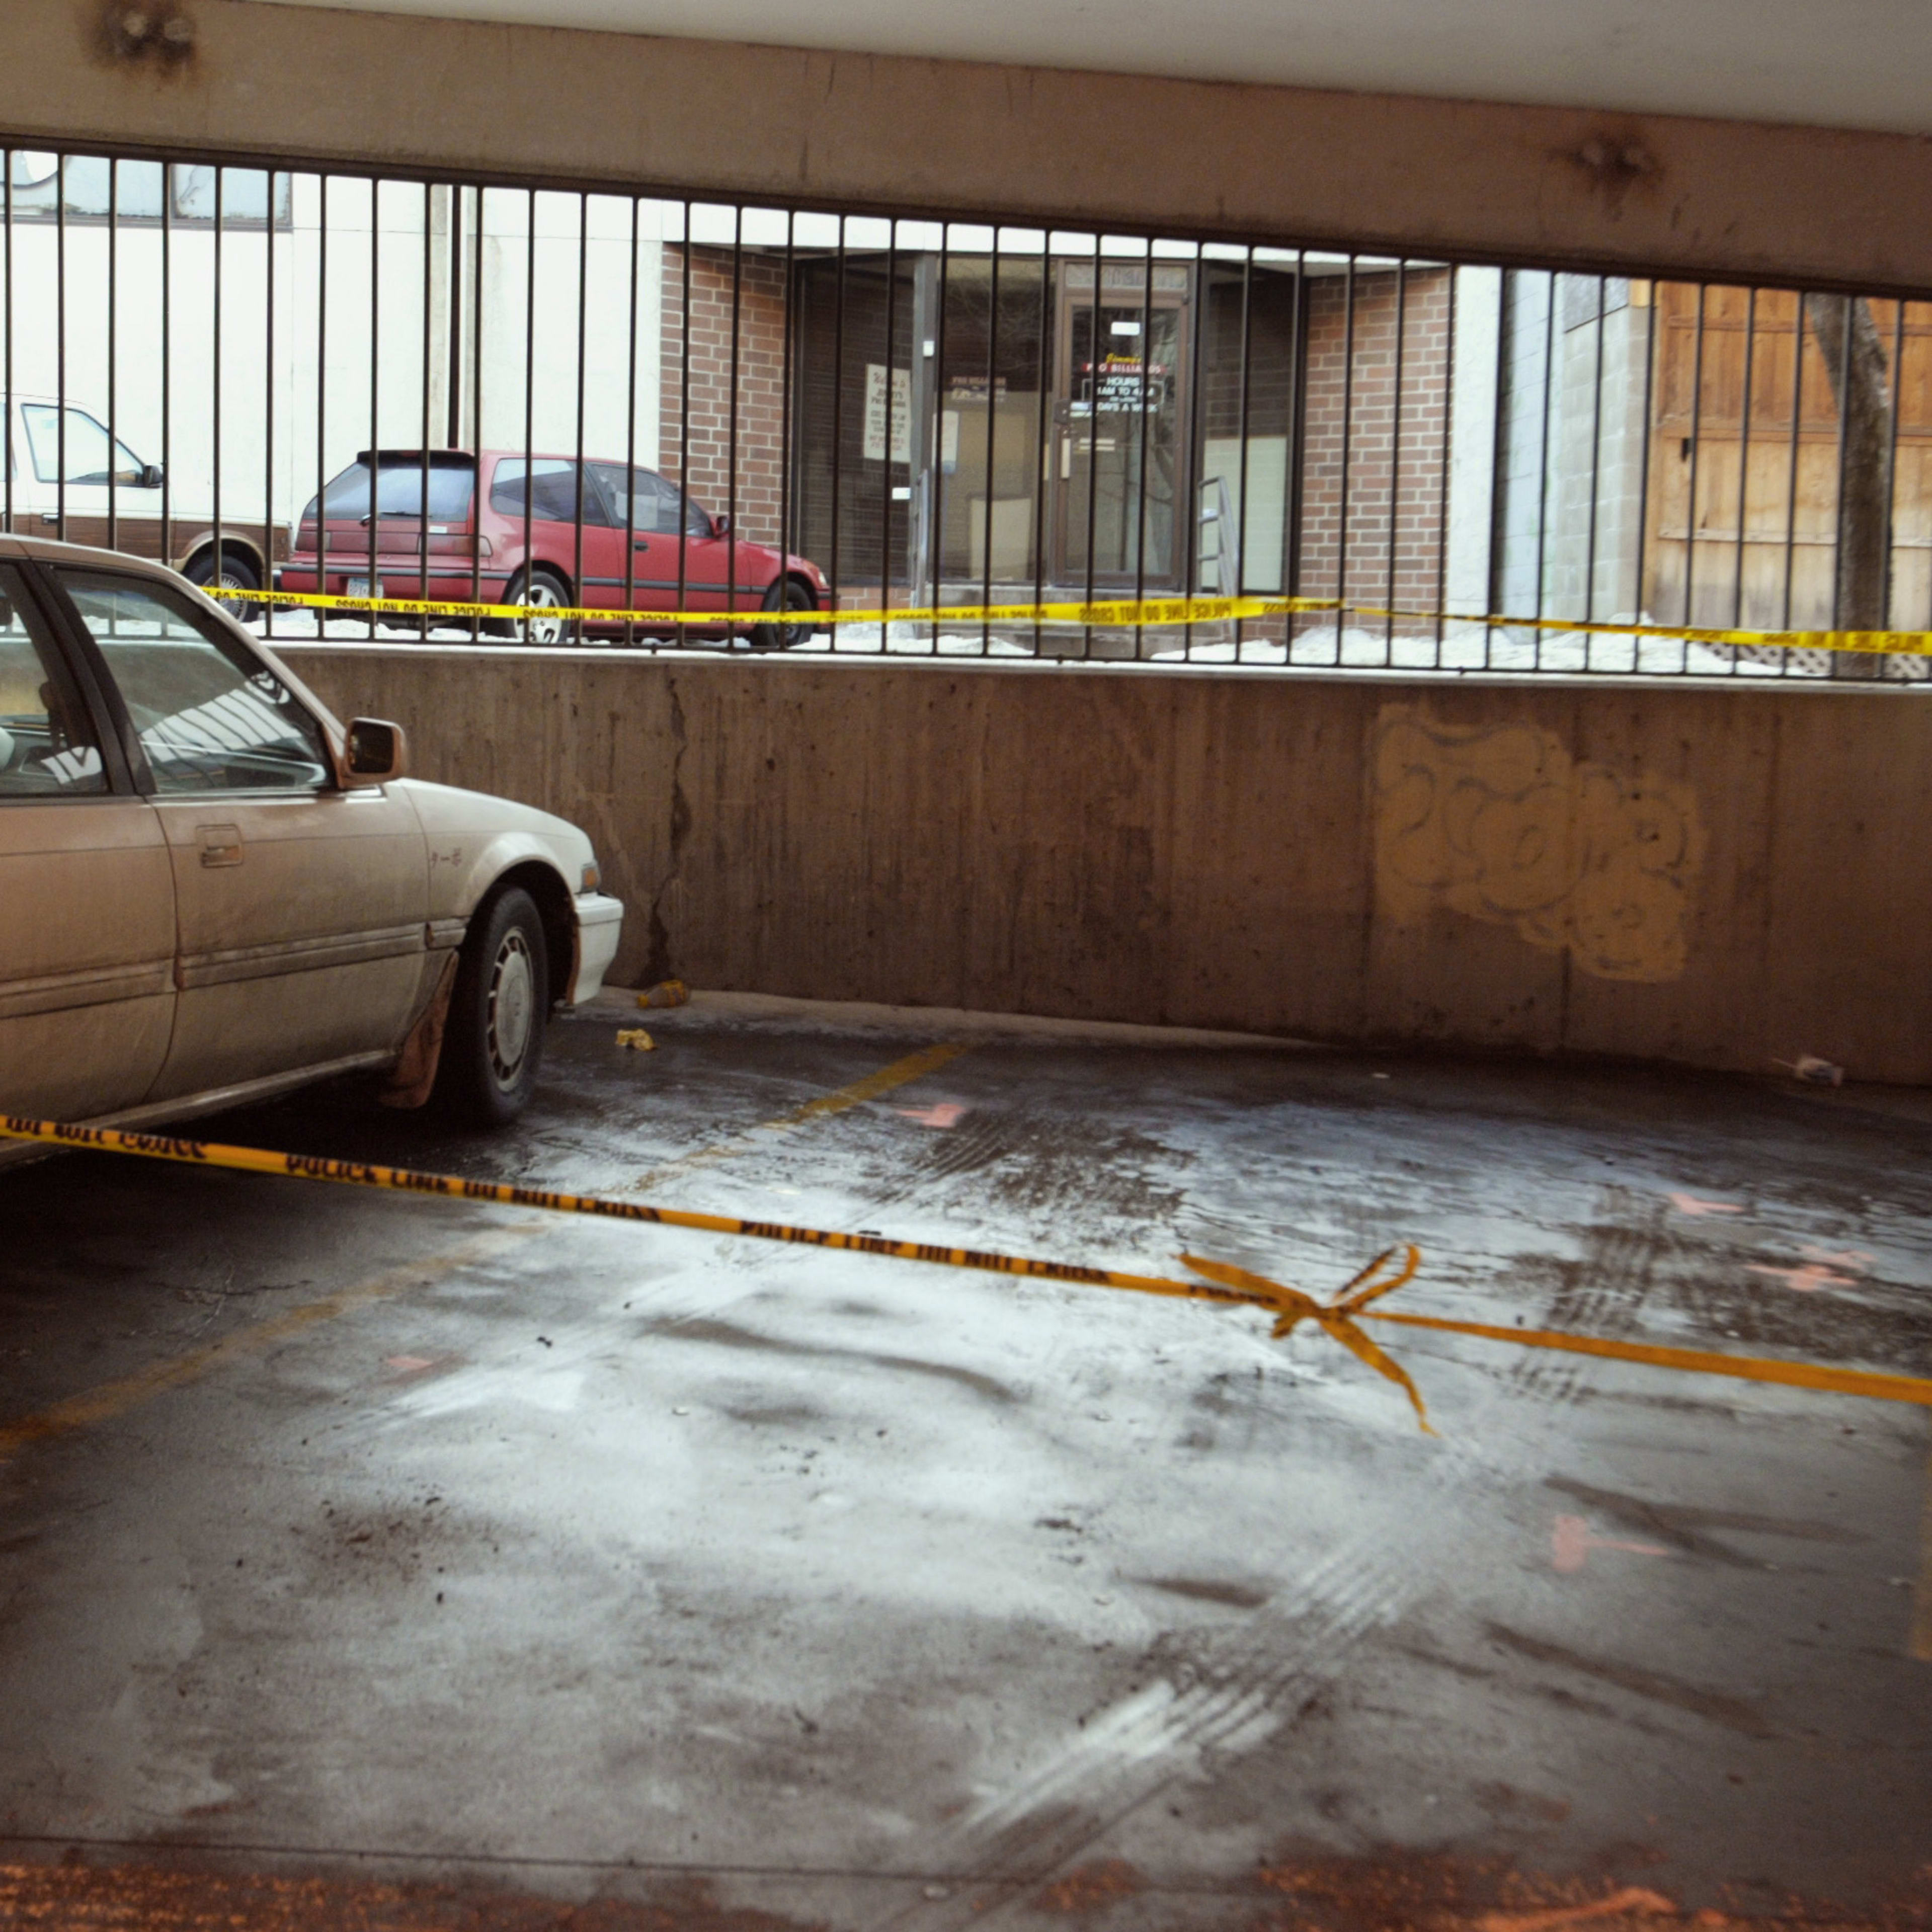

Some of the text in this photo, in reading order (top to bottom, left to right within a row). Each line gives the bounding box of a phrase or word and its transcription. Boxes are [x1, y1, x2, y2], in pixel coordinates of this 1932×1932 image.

[1086, 363, 1161, 374] PO BILLIADS
[1107, 376, 1140, 387] HOURS
[1118, 387, 1131, 395] TO
[1131, 404, 1158, 413] WK
